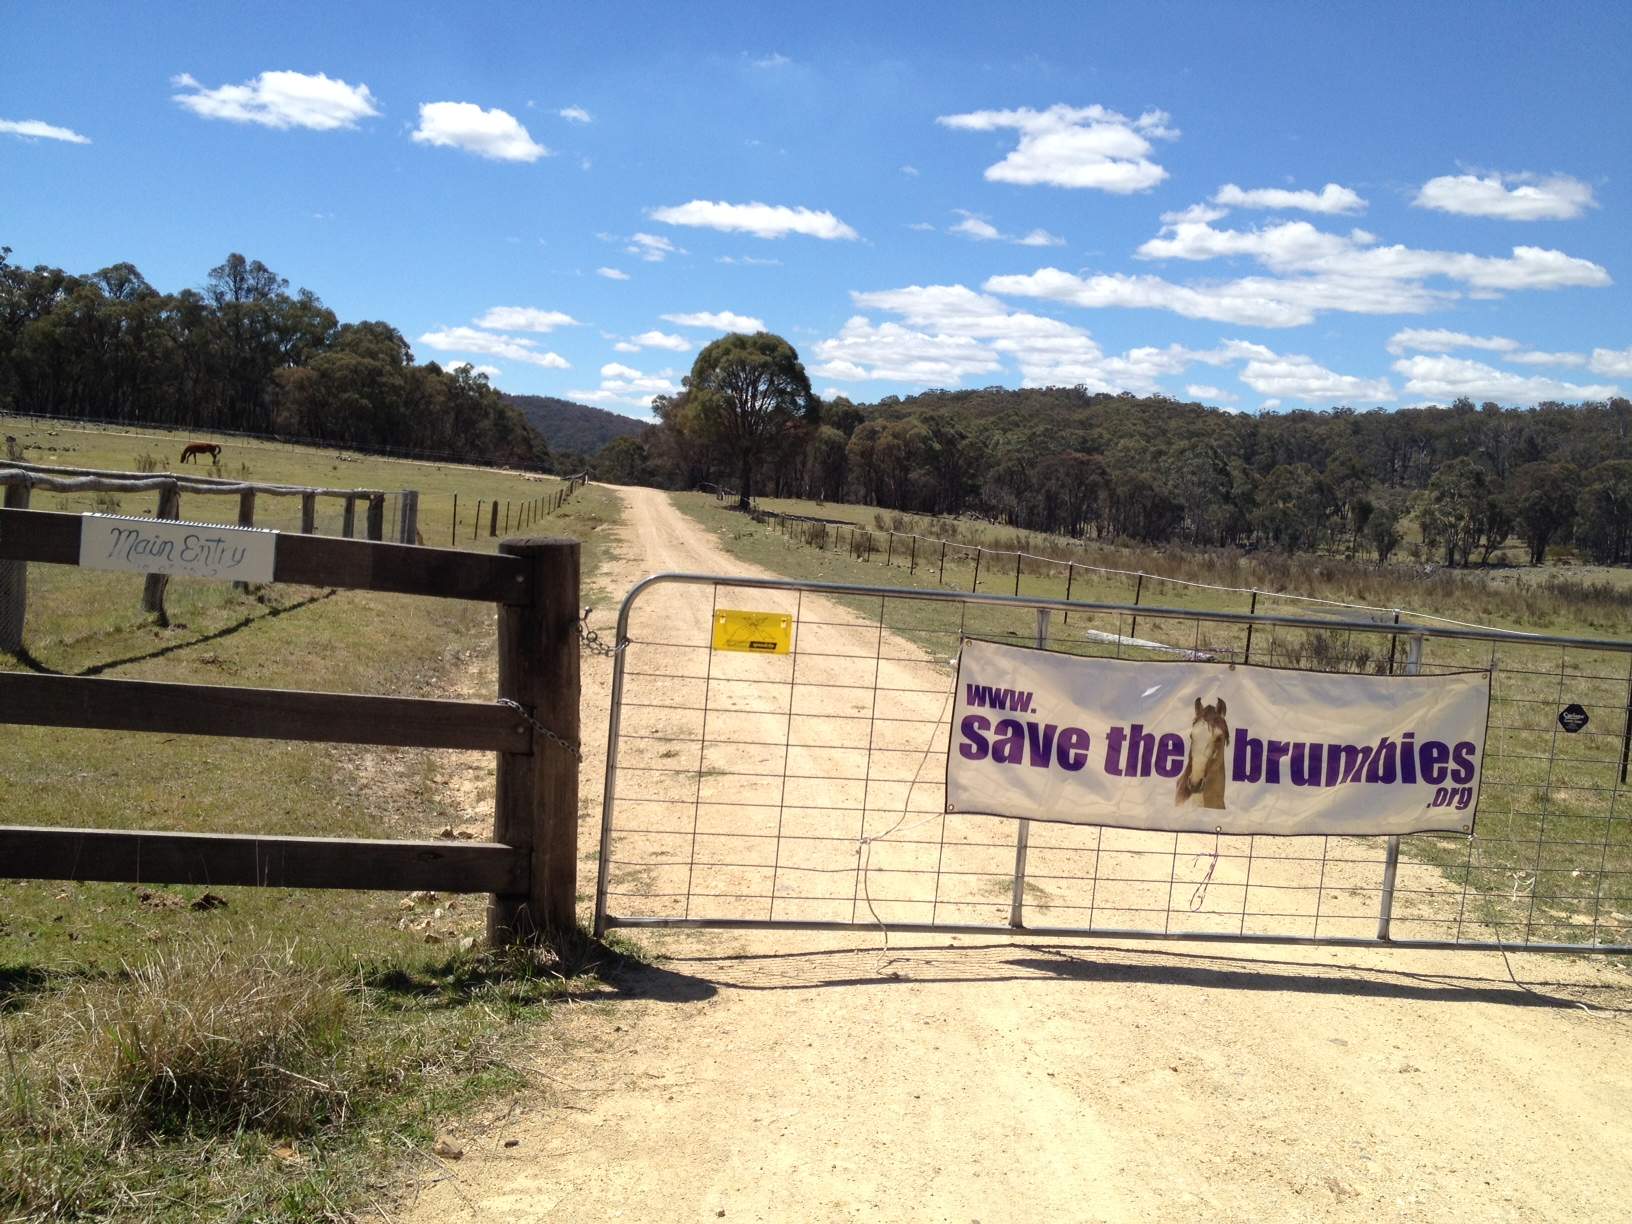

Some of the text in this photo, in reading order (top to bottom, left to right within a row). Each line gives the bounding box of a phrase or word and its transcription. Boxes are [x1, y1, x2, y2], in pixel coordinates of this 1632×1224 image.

[108, 527, 174, 563] Main
[966, 683, 1037, 714] www.
[959, 714, 1476, 787] save the brumbies
[1426, 786, 1473, 811] .org
